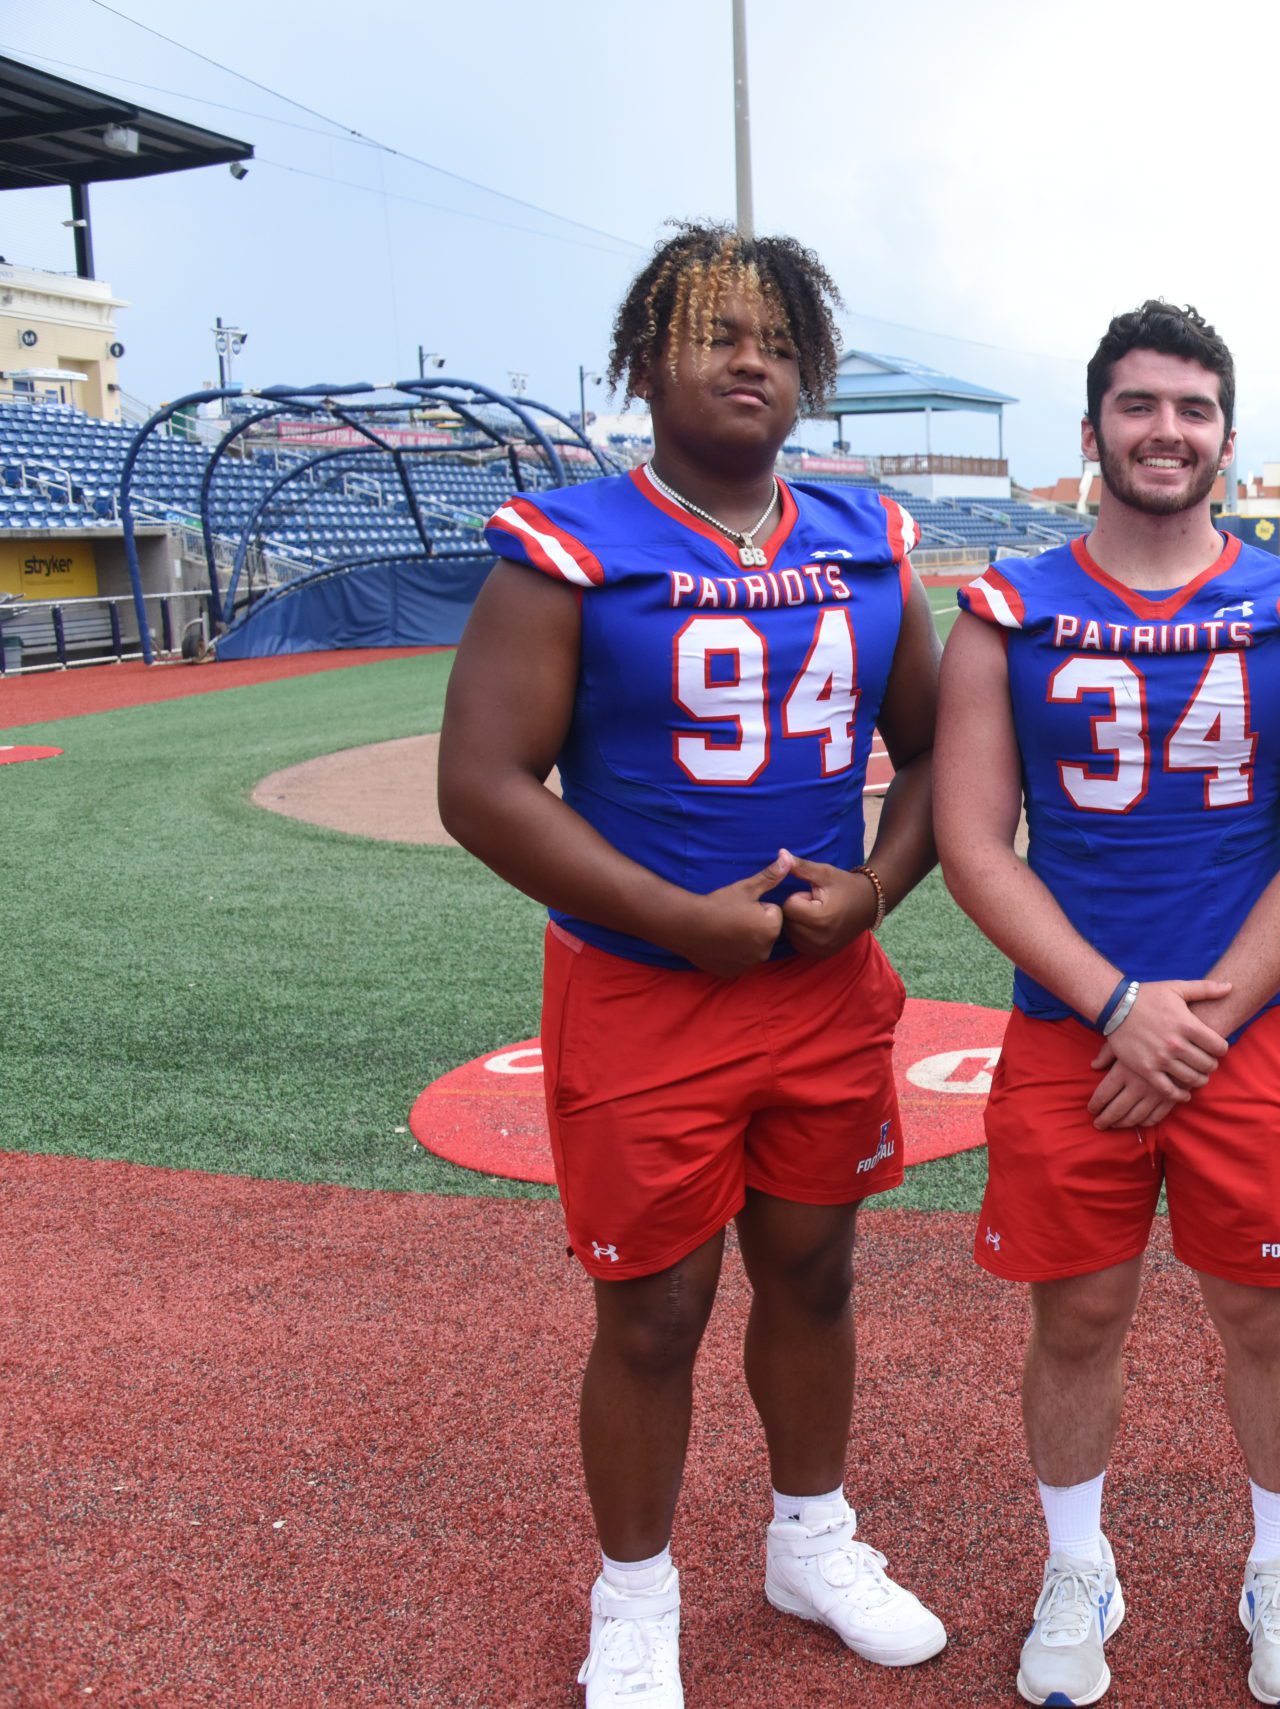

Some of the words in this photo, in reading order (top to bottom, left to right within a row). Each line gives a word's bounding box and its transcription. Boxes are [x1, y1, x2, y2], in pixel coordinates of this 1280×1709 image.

[24, 555, 73, 576] stryker
[670, 565, 853, 608] PATRIOTS
[1054, 613, 1254, 653] PATRIOTS
[671, 605, 862, 786] 94
[1046, 649, 1260, 815] 34
[856, 1139, 895, 1175] FOOALL
